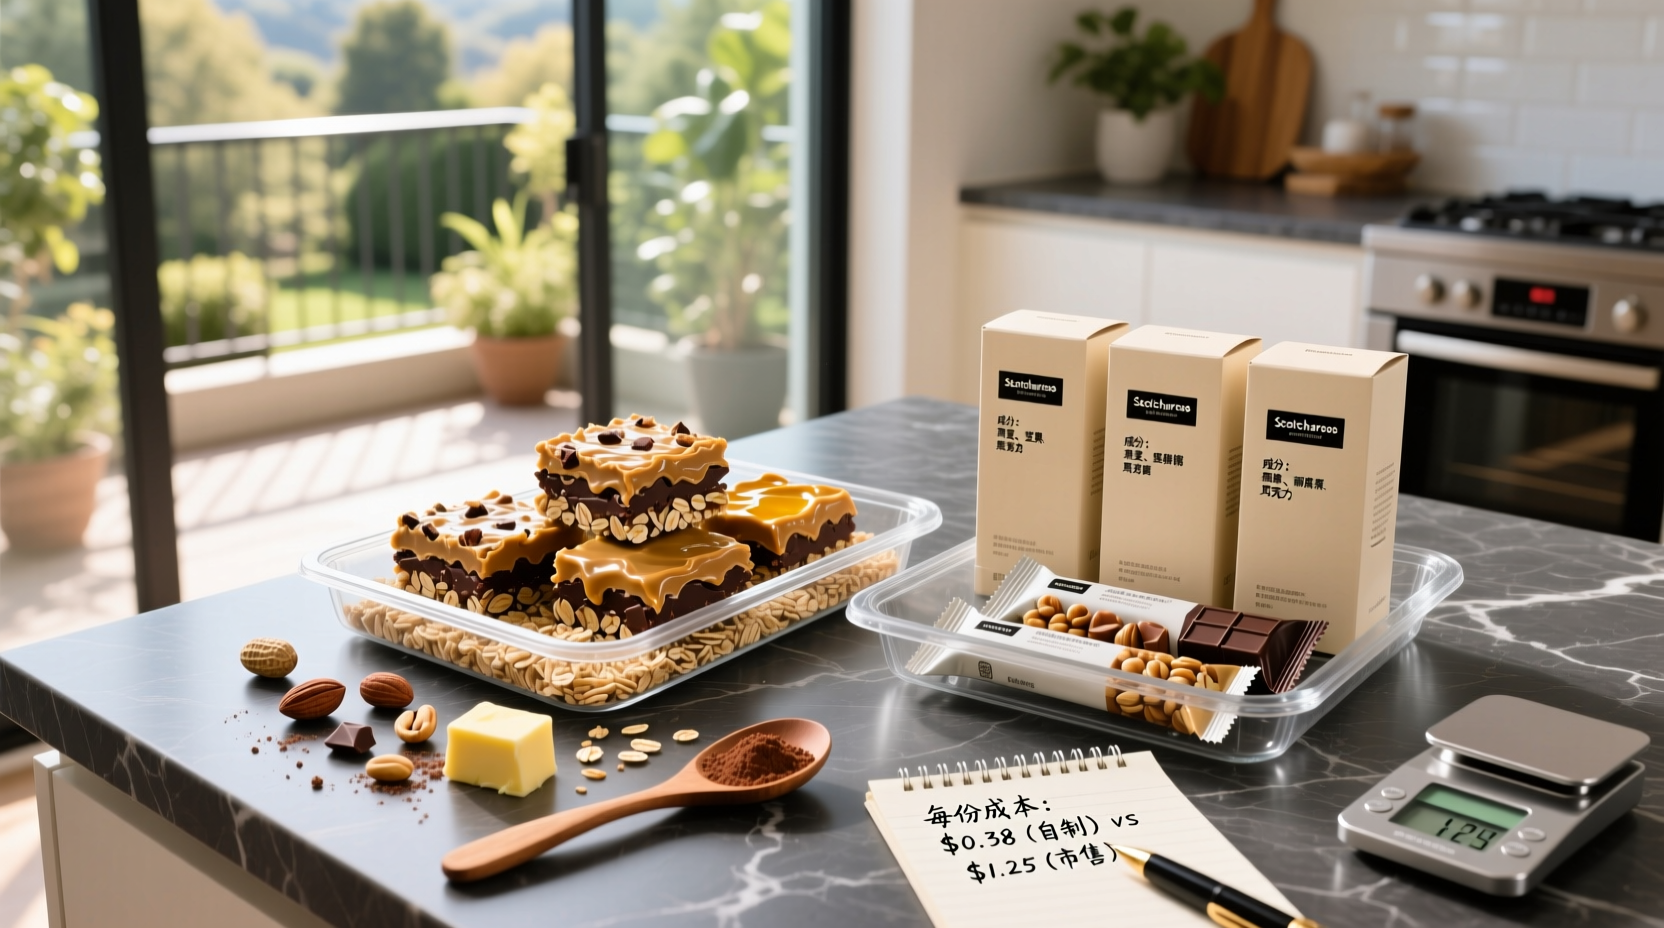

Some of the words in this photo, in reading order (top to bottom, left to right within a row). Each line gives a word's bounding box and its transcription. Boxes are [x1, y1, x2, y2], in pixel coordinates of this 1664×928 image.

[924, 795, 1051, 828] 每份成本：
[940, 828, 1016, 856] $0.38
[967, 856, 1036, 884] $1.25
